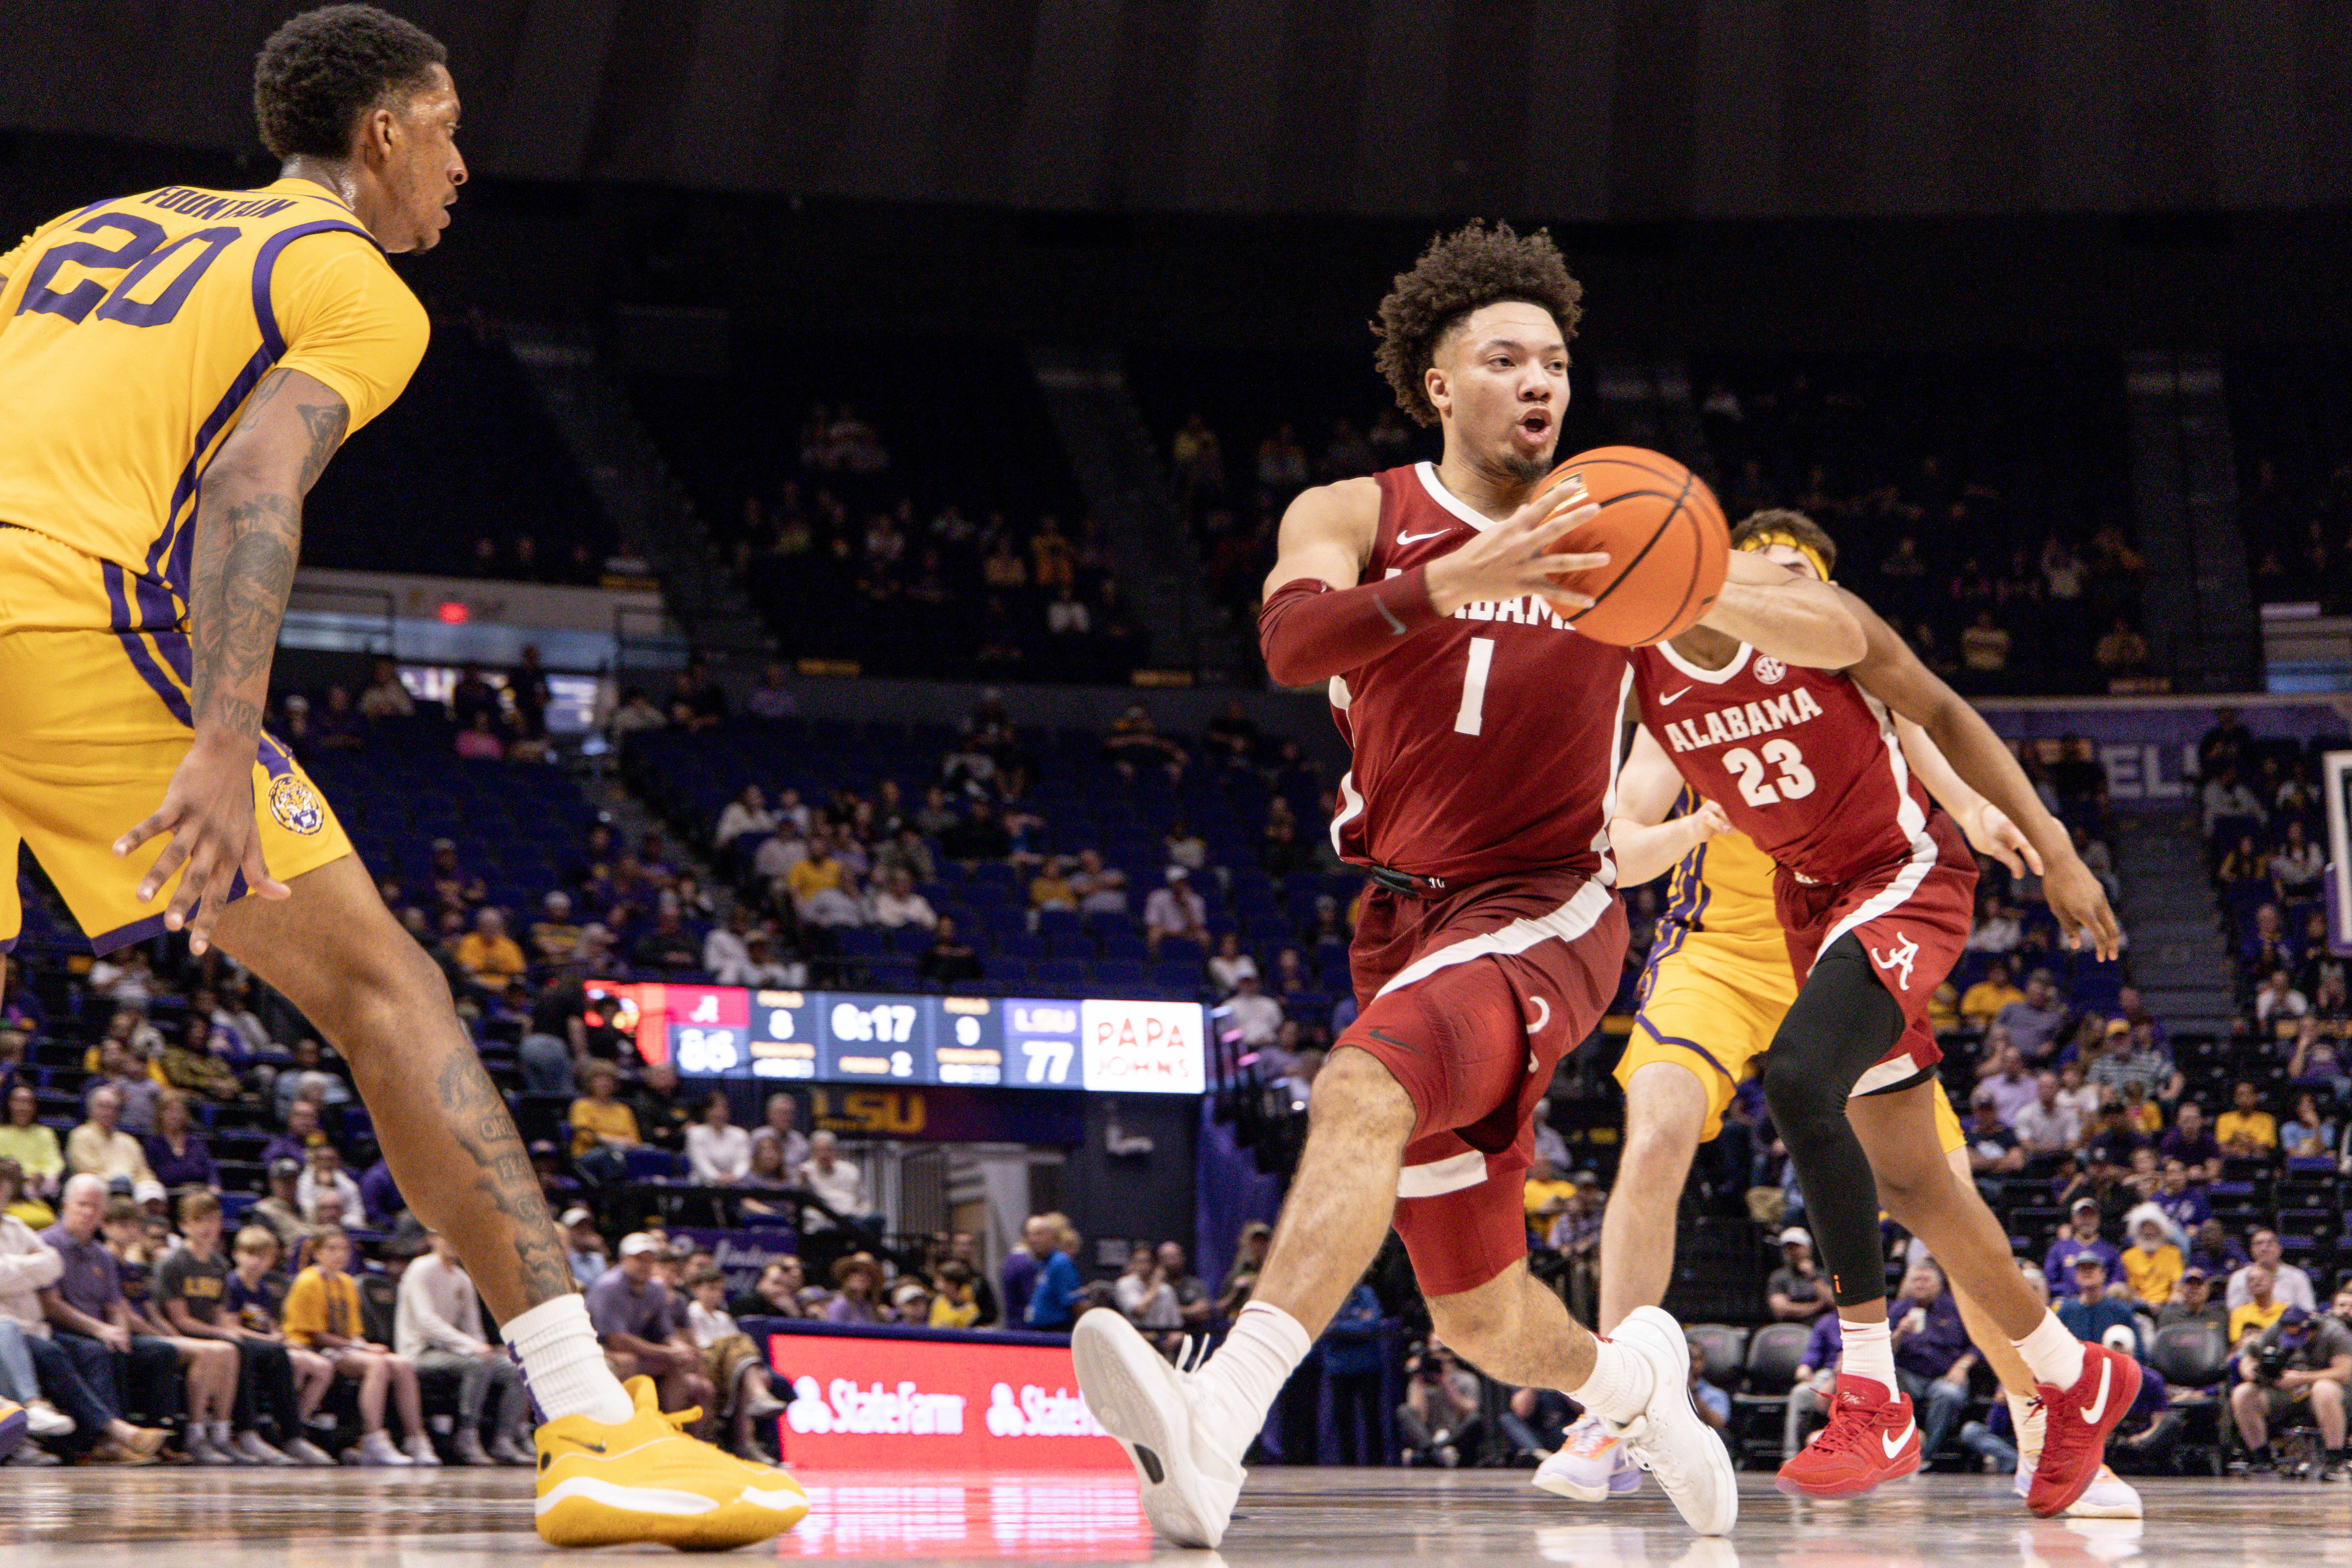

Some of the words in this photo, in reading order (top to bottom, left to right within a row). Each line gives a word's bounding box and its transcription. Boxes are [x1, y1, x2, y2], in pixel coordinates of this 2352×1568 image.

[141, 187, 298, 220] FOUNTAIN
[15, 212, 242, 328] 20
[1454, 637, 1495, 735] 1
[1664, 687, 1823, 753] ALABAMA
[1721, 738, 1816, 807] 23
[1014, 1008, 1077, 1033] LSU
[1098, 1017, 1185, 1048] PAPA
[1022, 1040, 1074, 1083] 77
[810, 1087, 925, 1132] LSU
